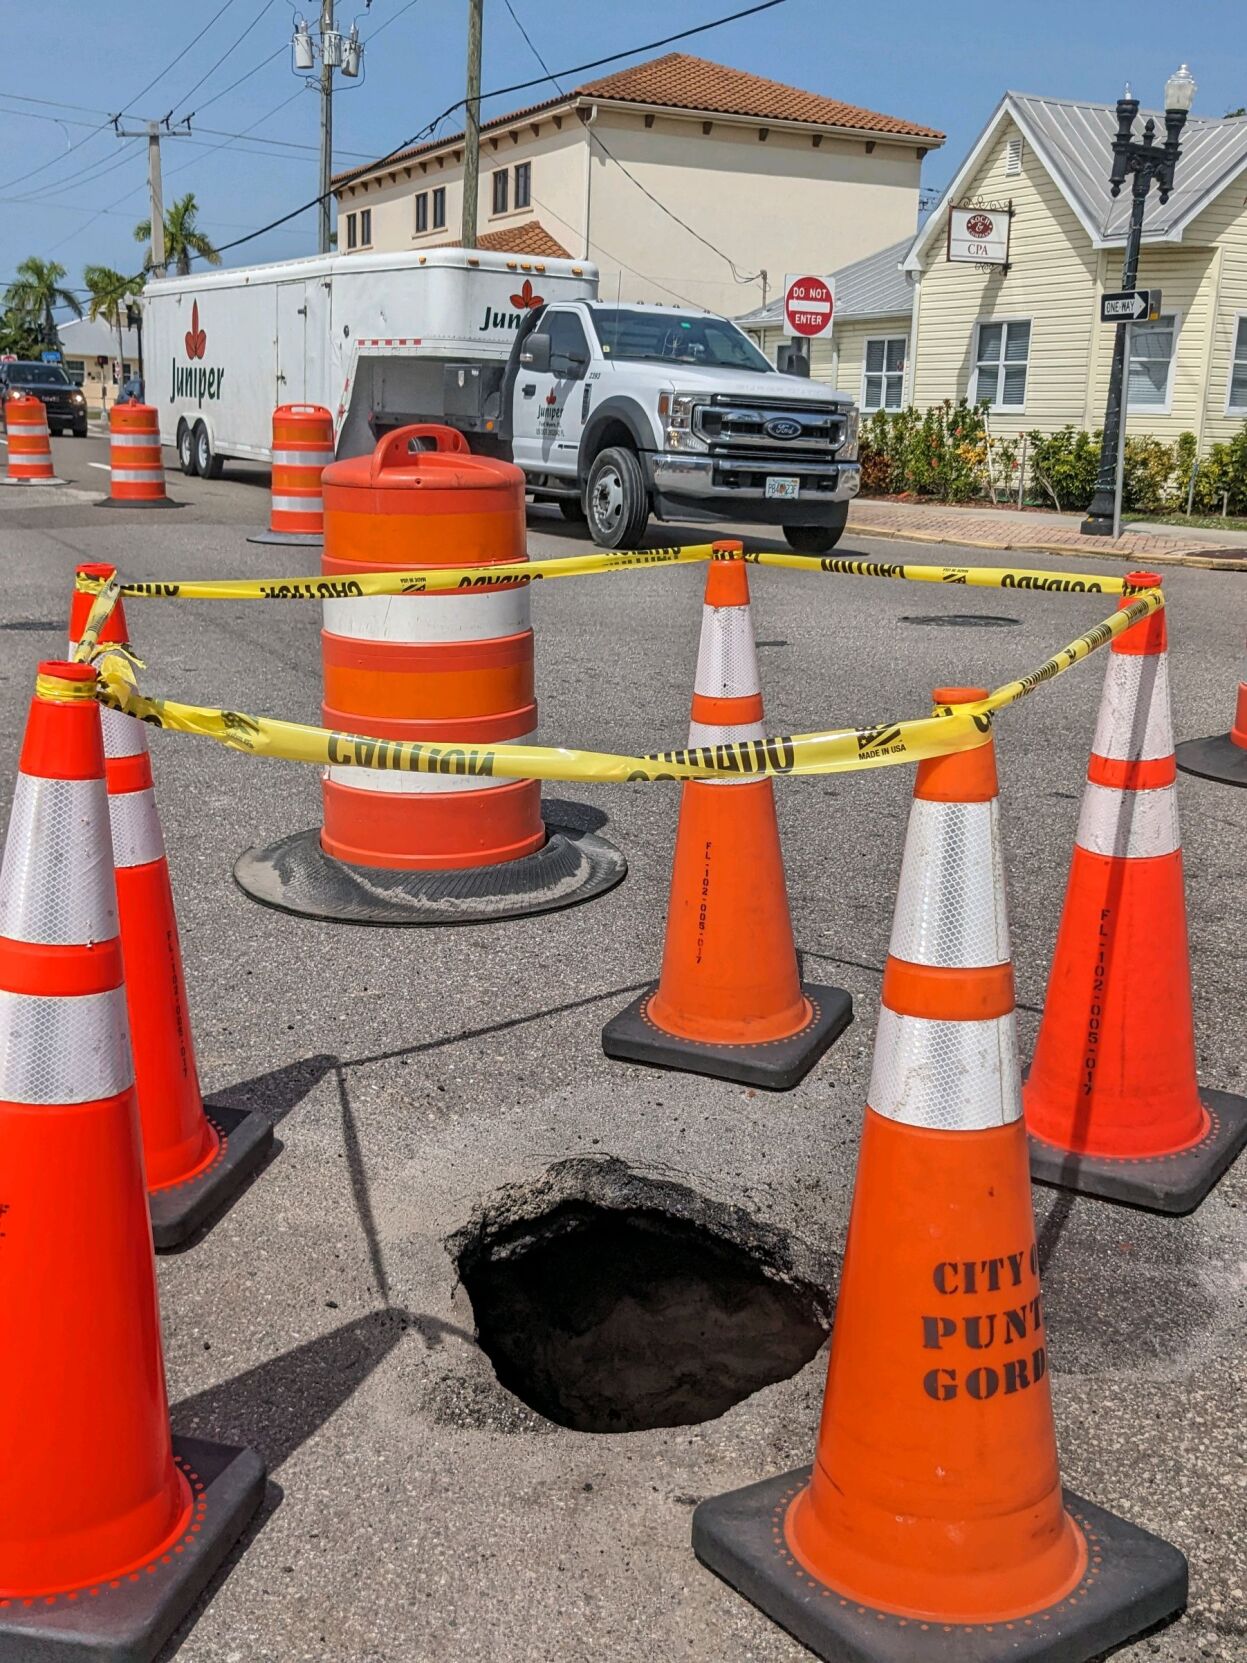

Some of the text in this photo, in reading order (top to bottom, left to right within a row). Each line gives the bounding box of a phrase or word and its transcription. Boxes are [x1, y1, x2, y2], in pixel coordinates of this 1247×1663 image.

[970, 216, 991, 226] KOCH
[975, 222, 984, 232] &
[967, 243, 989, 255] CPA
[793, 287, 827, 299] DO NOT
[1106, 300, 1135, 313] ONE WAY
[479, 306, 521, 331] Jun
[795, 313, 822, 325] ENTER
[170, 357, 224, 409] Juniper
[537, 404, 564, 419] Juniper
[775, 423, 794, 434] Ford
[858, 744, 907, 760] MADE IN USA
[932, 1251, 1024, 1295] CITY
[921, 1293, 1042, 1350] PUNT
[923, 1347, 1046, 1401] GORD
